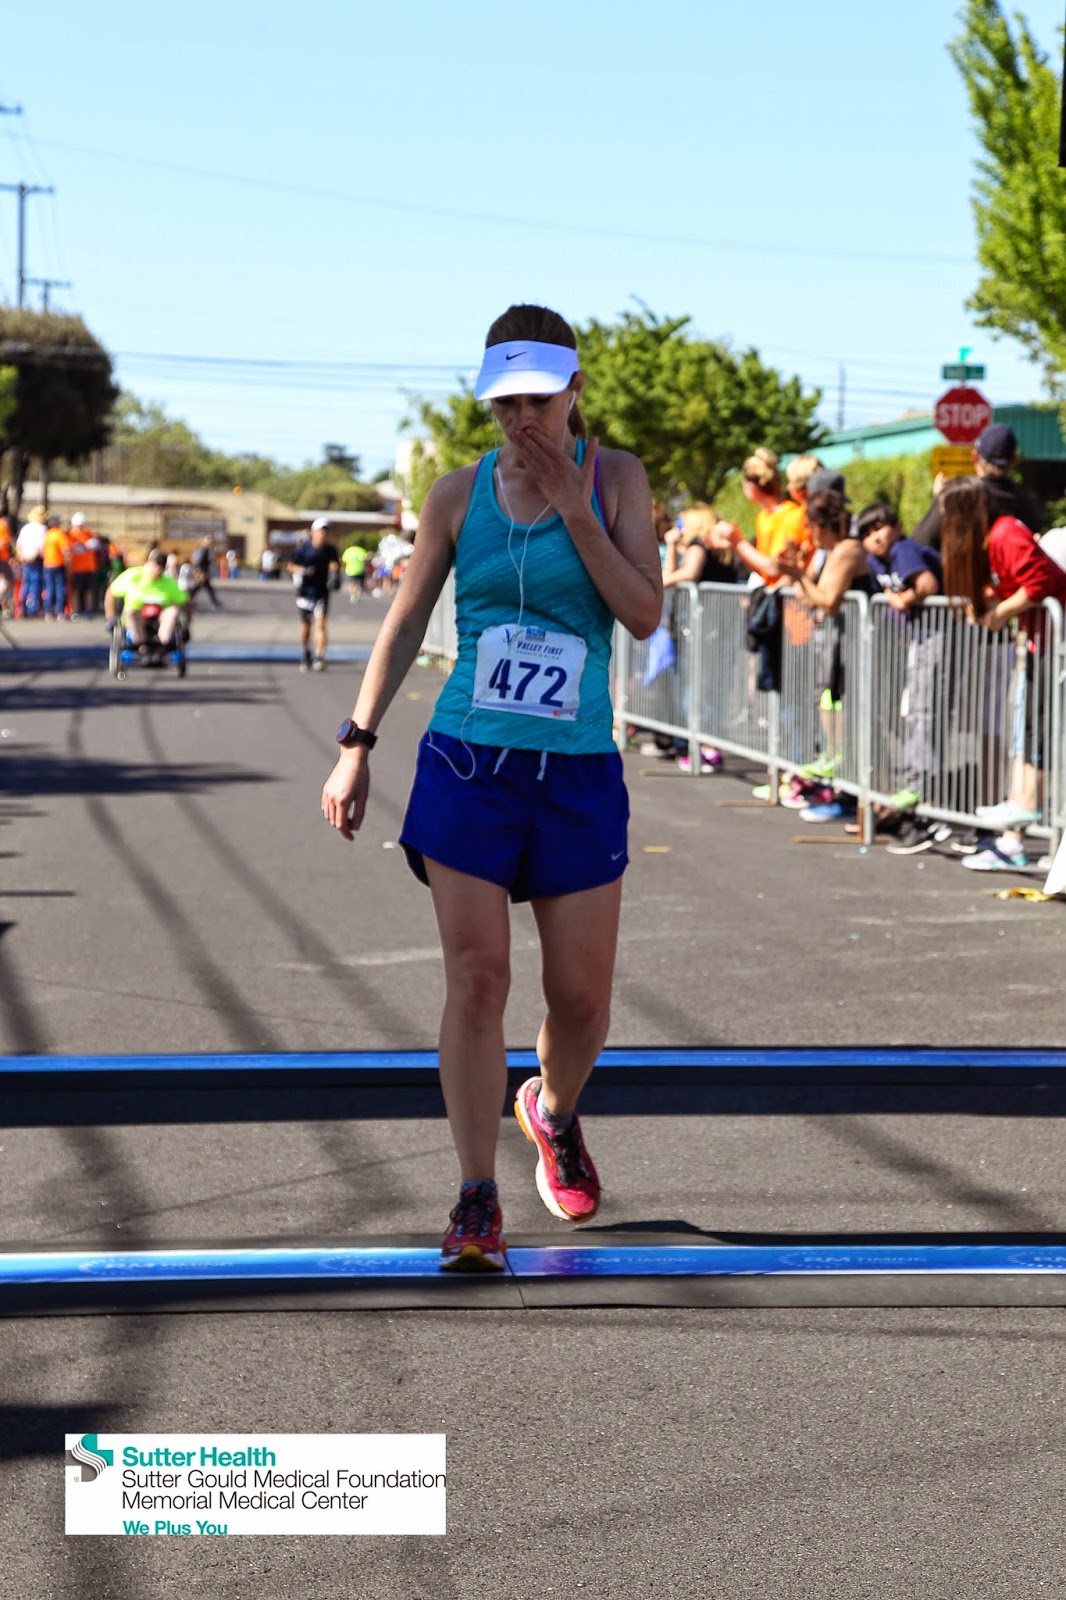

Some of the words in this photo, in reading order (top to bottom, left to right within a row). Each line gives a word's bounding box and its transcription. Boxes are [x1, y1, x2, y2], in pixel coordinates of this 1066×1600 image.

[937, 403, 990, 427] STOP
[517, 641, 542, 651] VALLEY
[542, 645, 564, 656] FIRST
[488, 658, 567, 707] 472
